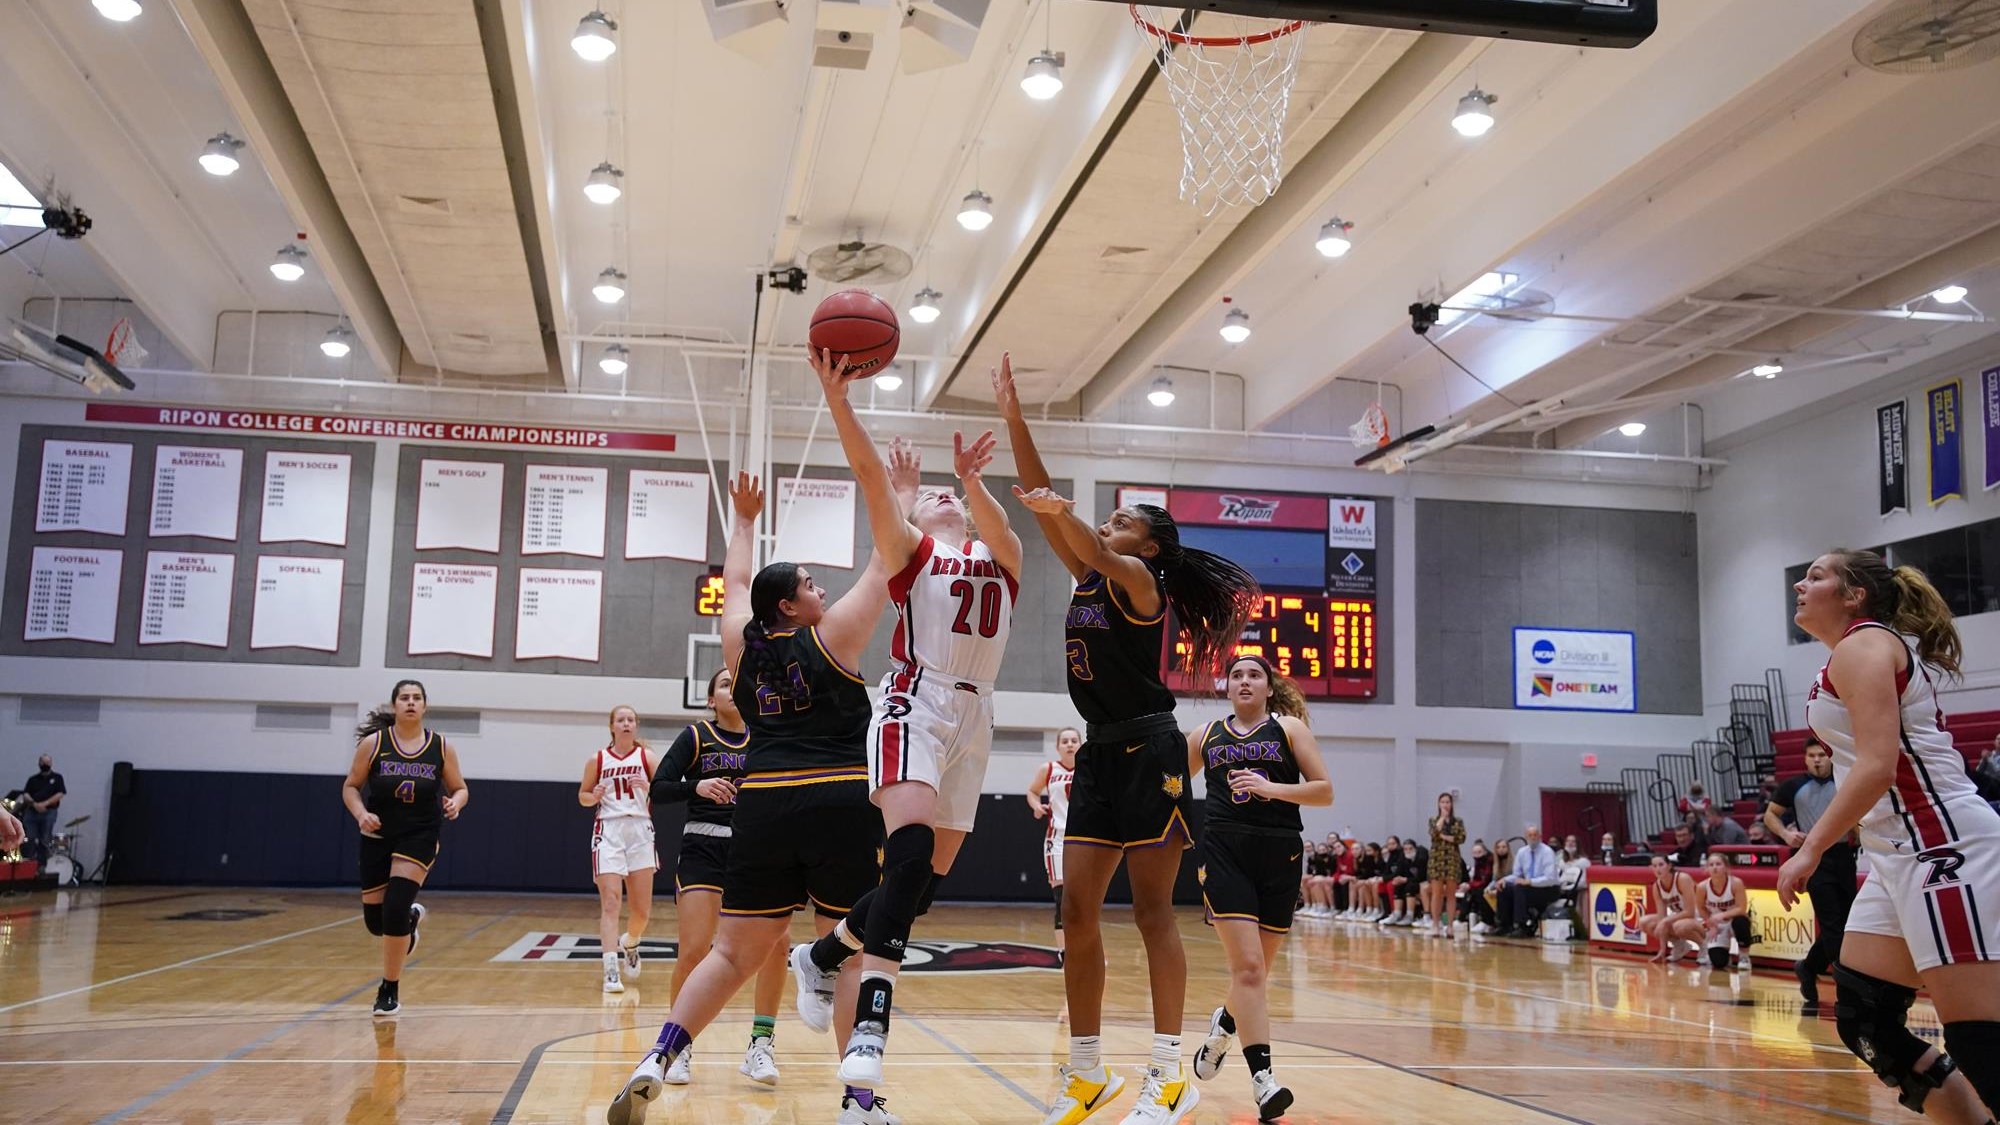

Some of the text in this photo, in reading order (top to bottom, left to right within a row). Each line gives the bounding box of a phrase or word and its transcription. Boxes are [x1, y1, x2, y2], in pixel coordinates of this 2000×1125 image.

[159, 409, 608, 448] RIPON COLLEGE CONFERENCE CHAMPIONSHIPS
[1892, 406, 1904, 466] MIDWEST
[65, 450, 110, 458] BASEBALL
[172, 459, 226, 467] BASKETBALL
[644, 479, 694, 488] VOLLEYBALL
[1340, 506, 1364, 524] W
[54, 556, 100, 564] FOOTBALL
[162, 564, 217, 572] BASKETBALL
[931, 556, 962, 576] RED
[280, 566, 321, 574] SOFTBALL
[950, 579, 1002, 638] 20
[1305, 612, 1319, 632] 4
[1280, 659, 1290, 676] 5
[1310, 660, 1320, 677] 3
[1555, 682, 1618, 694] ONETEAM
[1208, 741, 1282, 770] KNOX
[380, 760, 437, 780] KNOX
[395, 780, 416, 803] 4
[1764, 916, 1814, 944] RIPON
